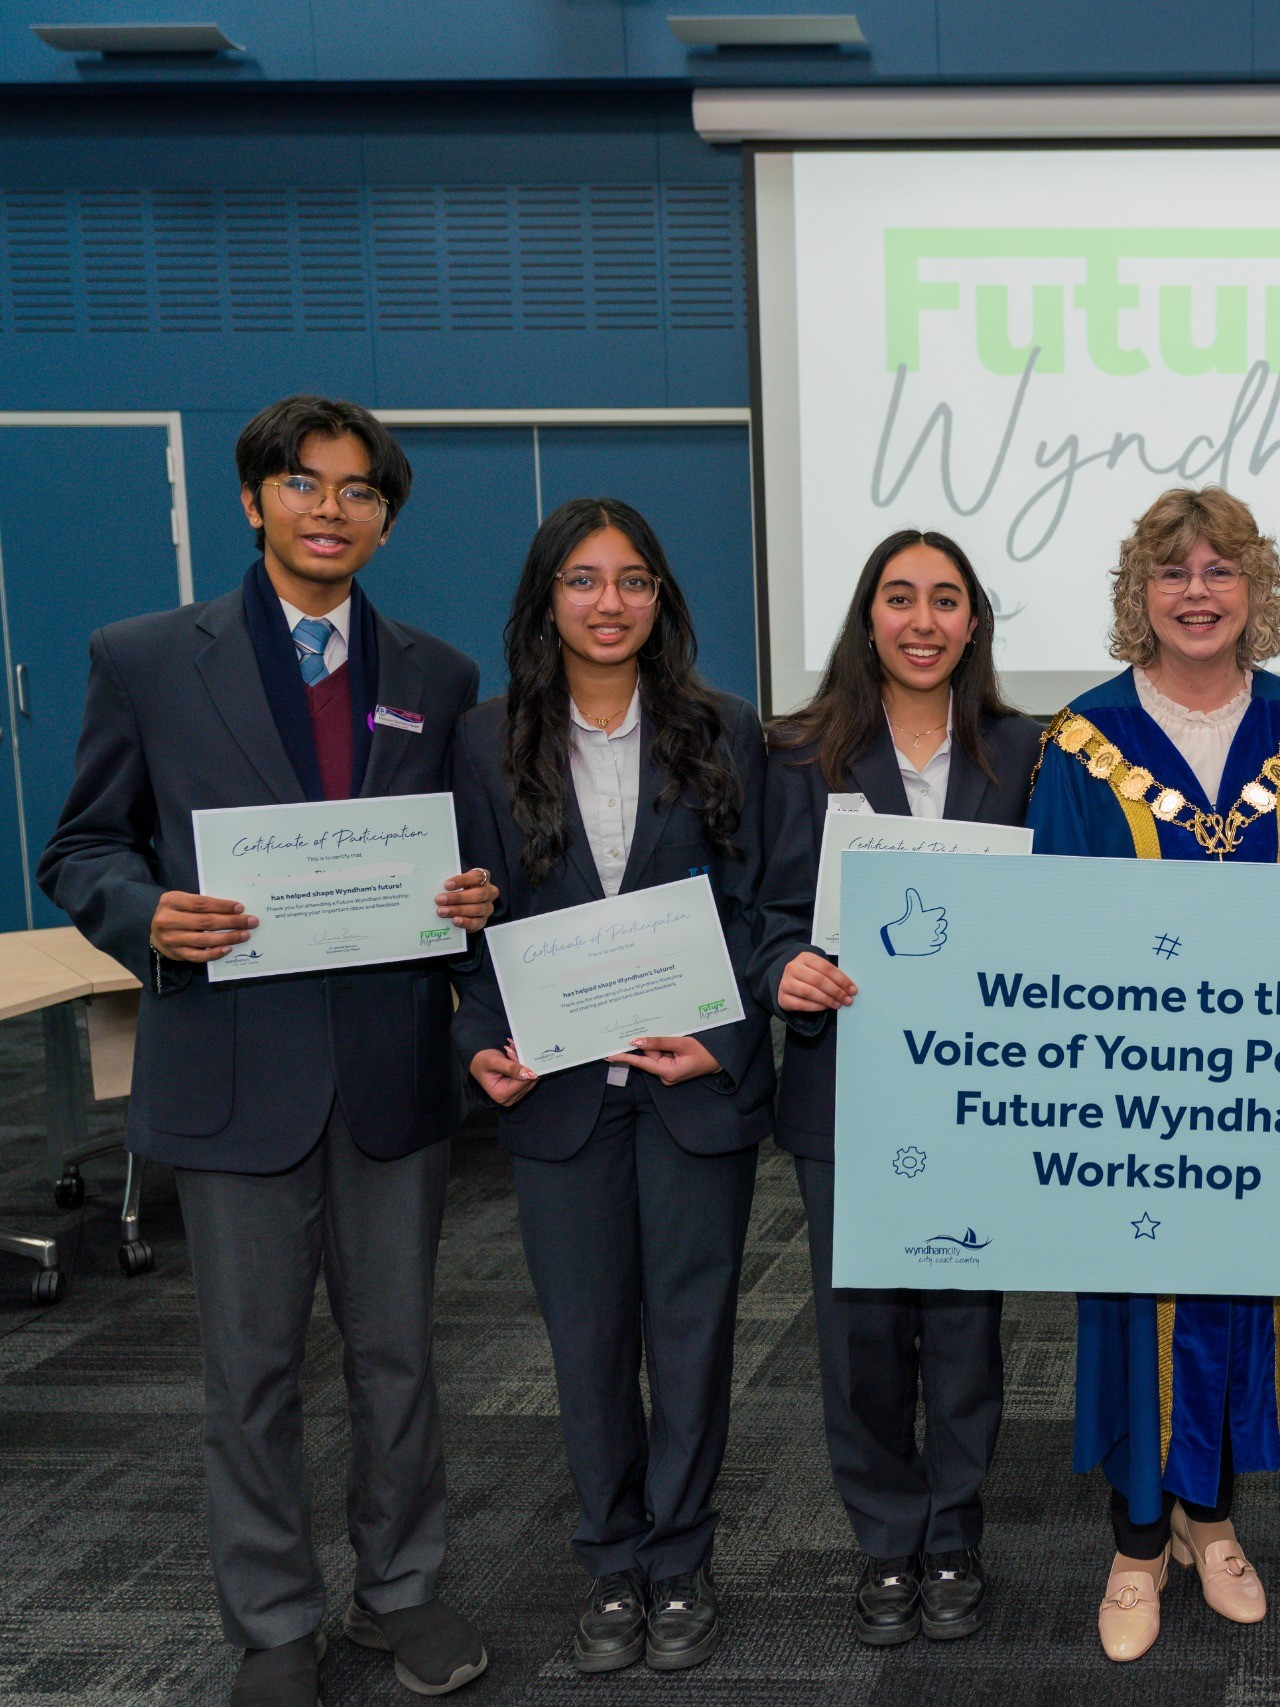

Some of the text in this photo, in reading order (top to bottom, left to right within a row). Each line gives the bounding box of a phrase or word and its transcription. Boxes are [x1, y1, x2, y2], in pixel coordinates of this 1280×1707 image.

[232, 824, 428, 857] Certificate of Participation
[286, 891, 311, 900] helped
[312, 890, 334, 898] shape
[335, 885, 377, 896] Wyndham's
[377, 882, 402, 890] future!
[421, 928, 449, 939] Future
[523, 933, 587, 963] Certificate
[606, 910, 690, 941] Participation
[575, 984, 597, 995] helped
[616, 970, 653, 984] Wyndham's
[653, 964, 675, 974] future!
[977, 972, 1186, 1012] Welcome
[1197, 981, 1243, 1014] to
[903, 1030, 1026, 1067] Voice
[1038, 1034, 1088, 1068] of
[1095, 1035, 1232, 1083] Young
[957, 1091, 1103, 1128] Future
[1033, 1152, 1261, 1199] Workshop
